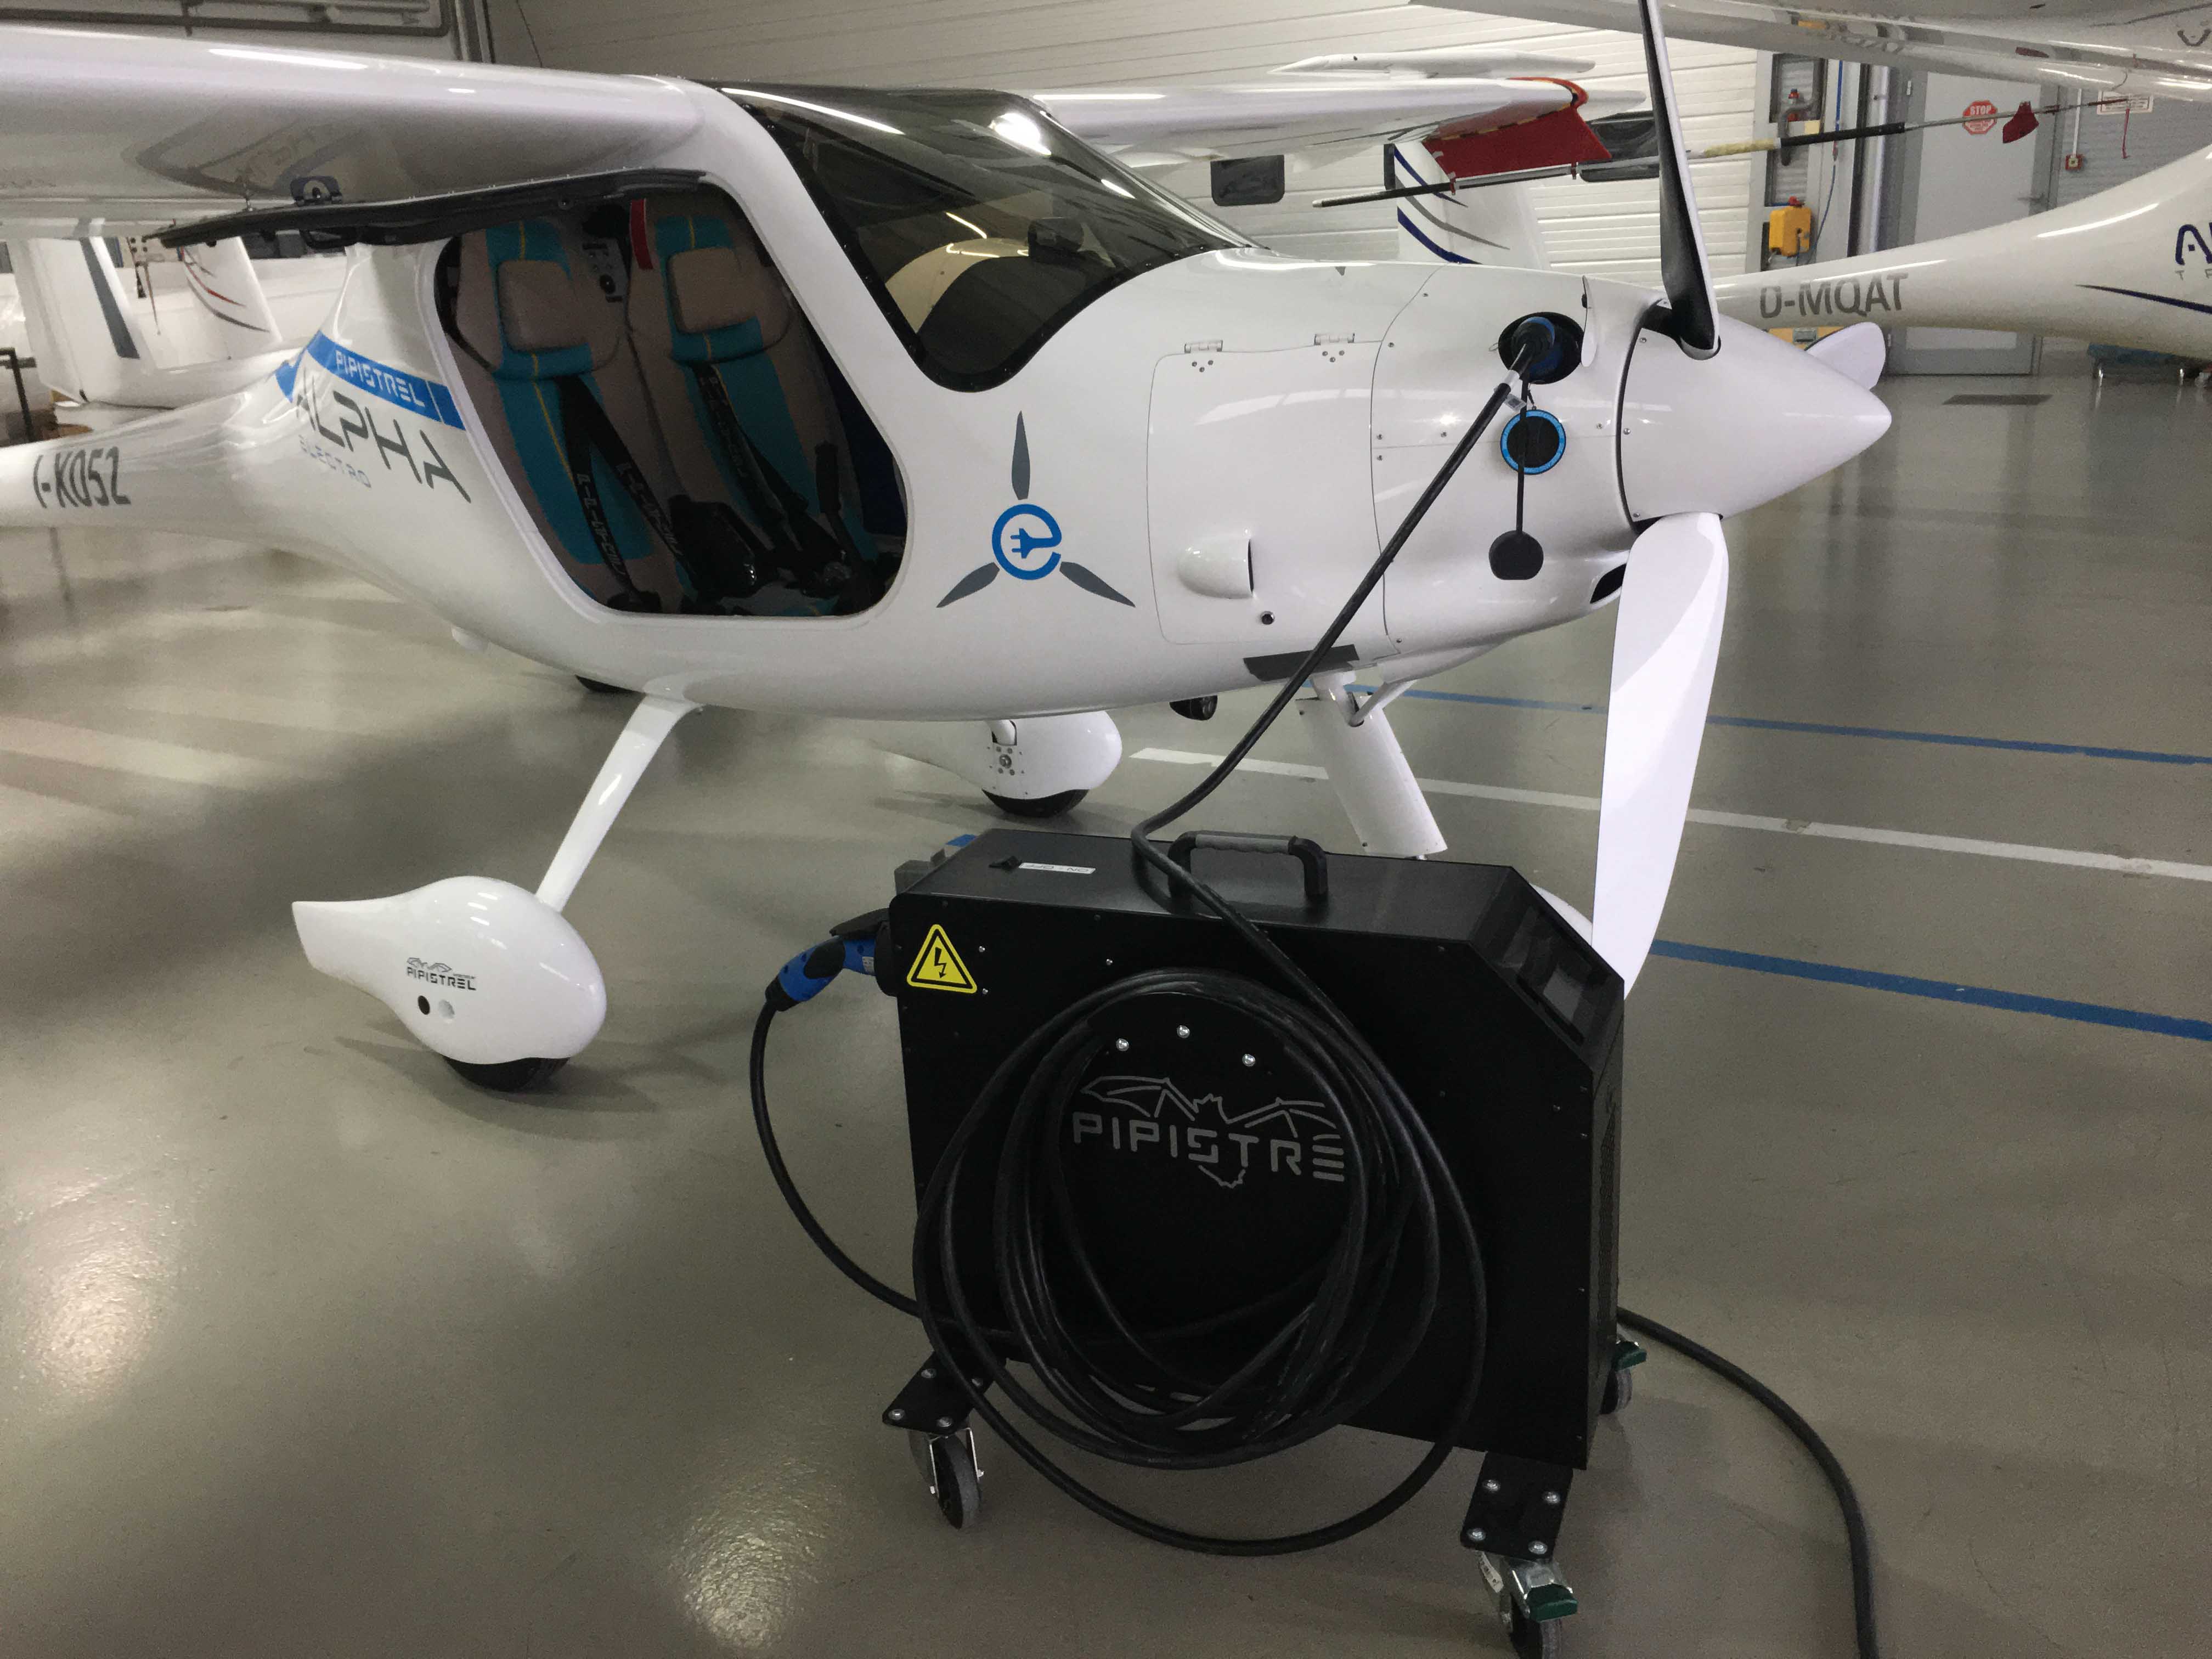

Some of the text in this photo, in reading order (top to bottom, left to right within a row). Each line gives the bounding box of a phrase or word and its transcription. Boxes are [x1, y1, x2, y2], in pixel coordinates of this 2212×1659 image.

[1970, 104, 1991, 115] STOP
[2175, 222, 2212, 266] A
[1759, 273, 1909, 318] D-MQAT
[335, 350, 425, 408] PIPISTREL
[296, 366, 472, 504] ALPHA
[407, 966, 476, 991] PIPISTREL
[1073, 1111, 1345, 1182] PIPISTRE
